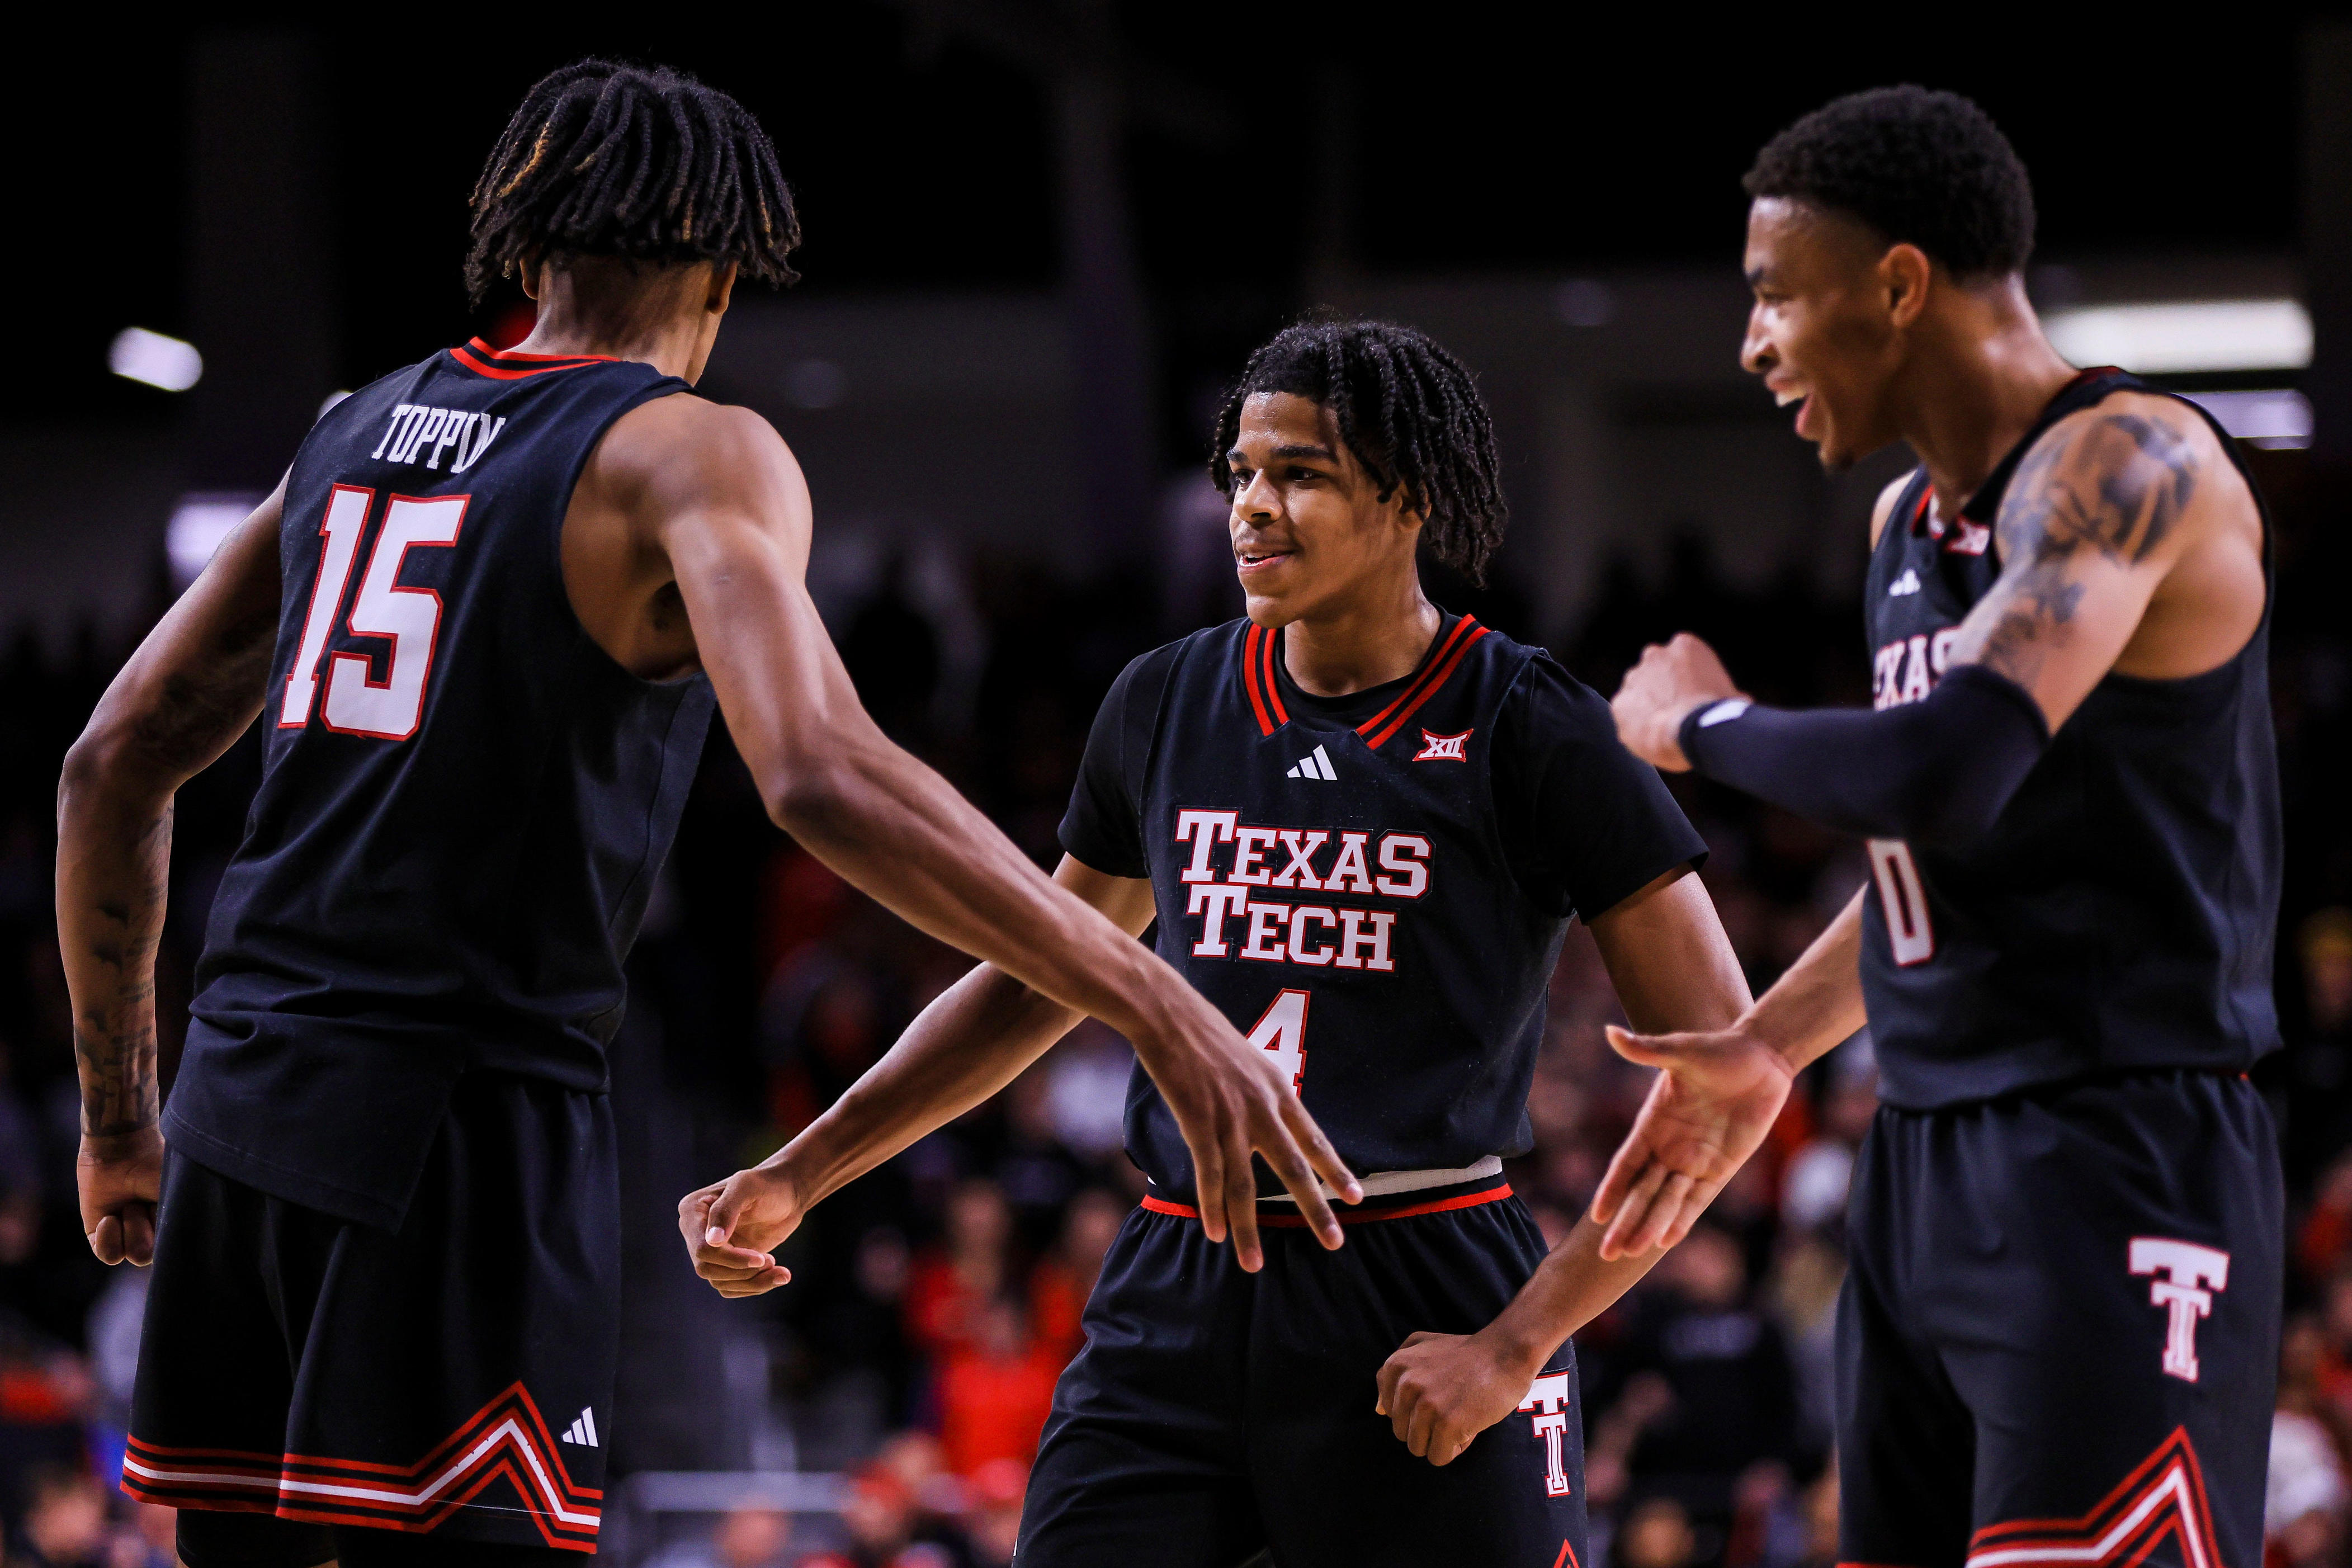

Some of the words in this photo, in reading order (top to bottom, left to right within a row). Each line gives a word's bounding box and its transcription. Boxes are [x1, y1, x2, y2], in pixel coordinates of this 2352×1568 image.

[371, 404, 506, 474] TOPPIN
[277, 483, 471, 742] 15
[1415, 730, 1471, 761] XII
[1175, 809, 1432, 899] TEXAS
[1186, 884, 1397, 972] TECH
[1865, 838, 1934, 966] 0
[1244, 988, 1310, 1098] 4
